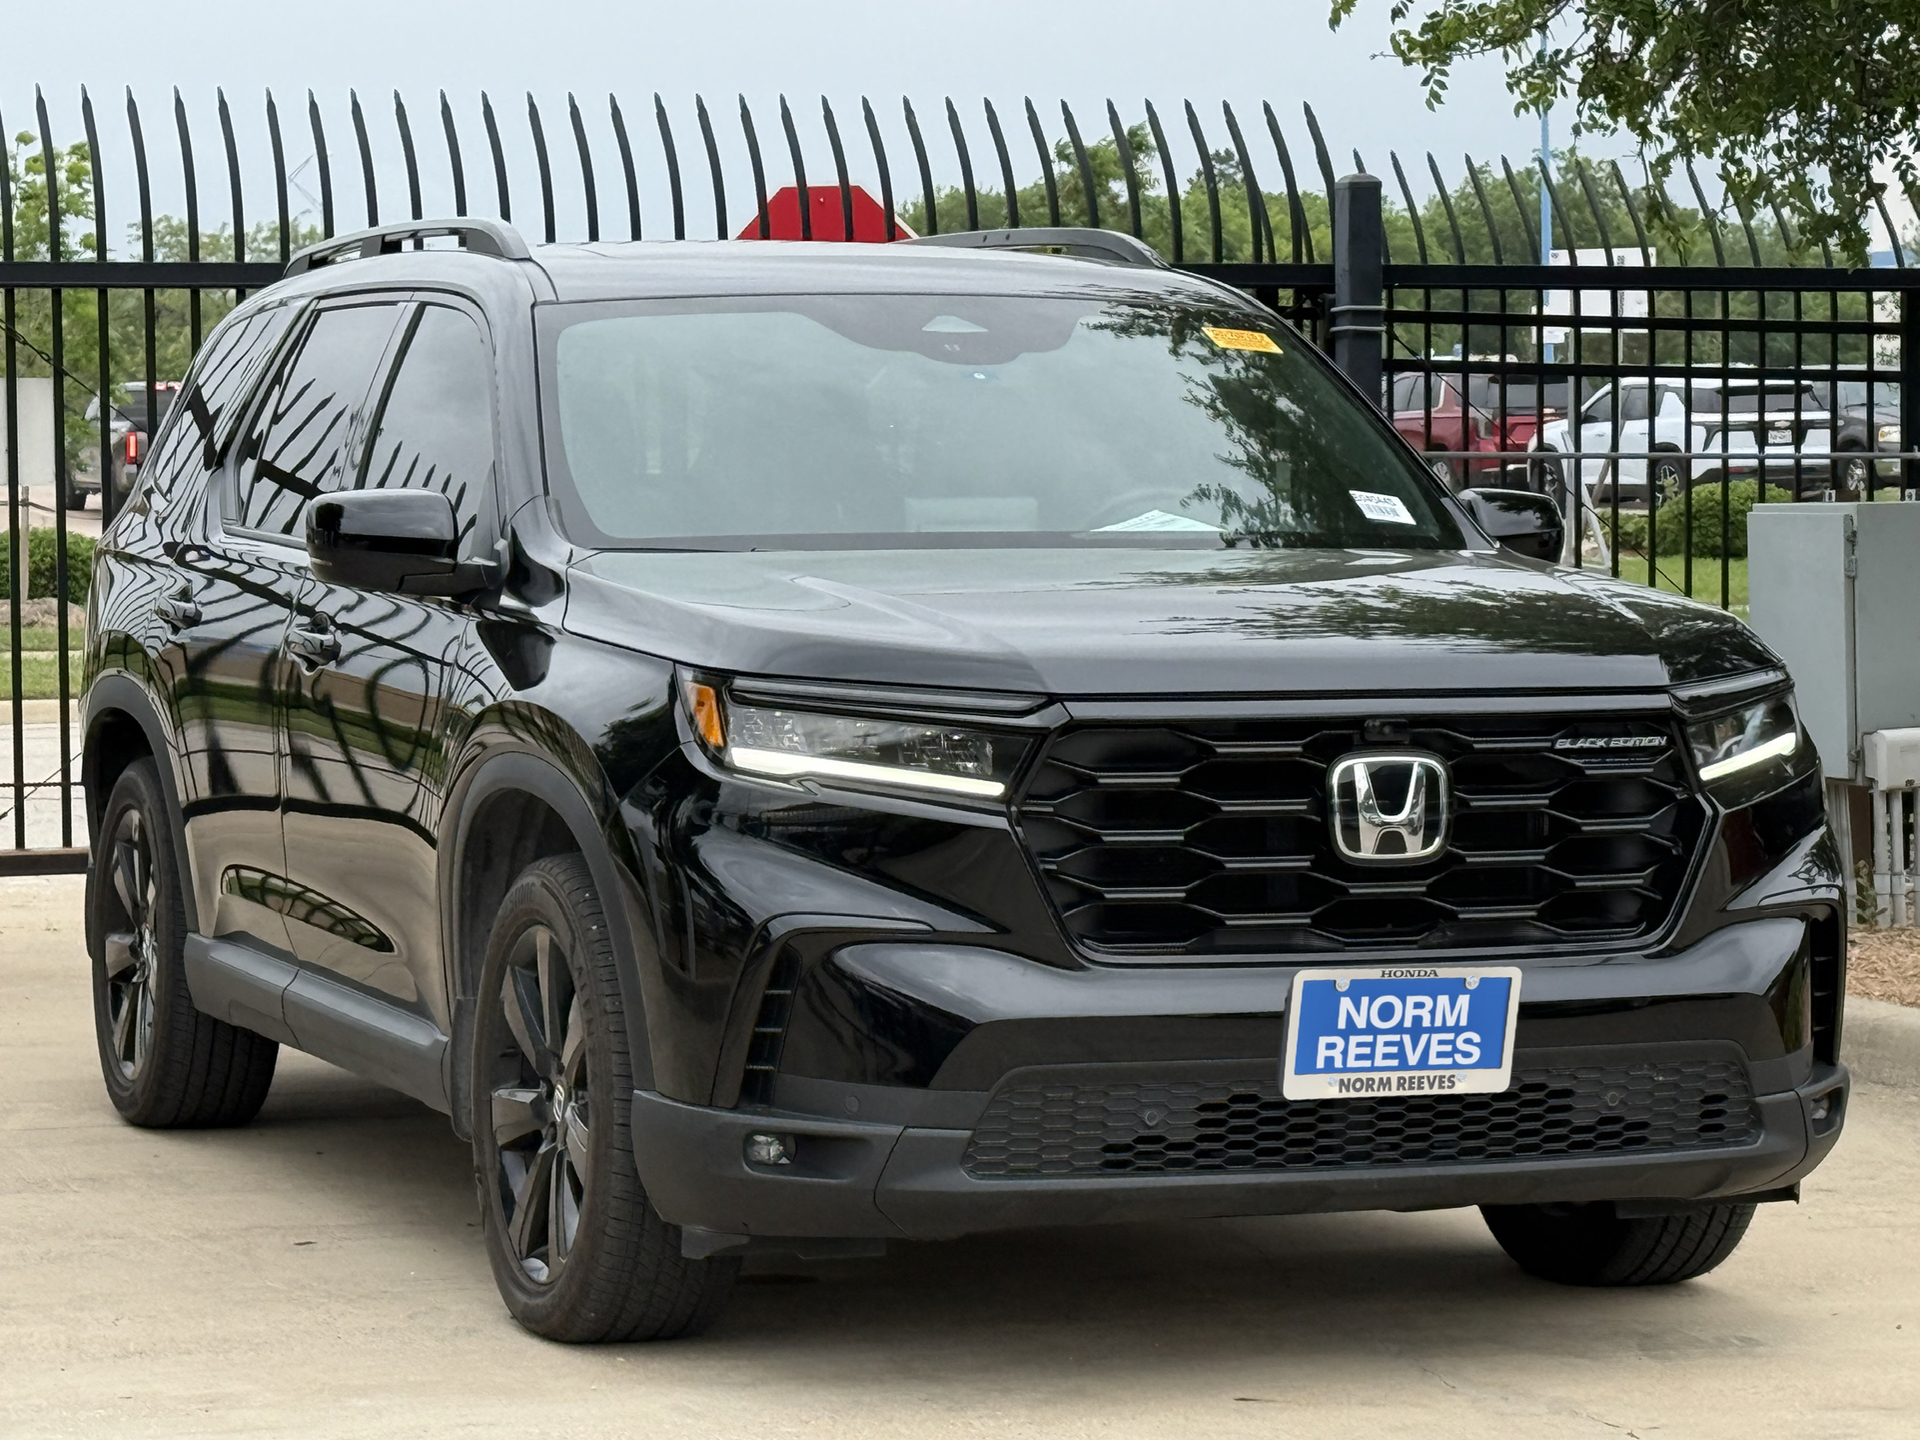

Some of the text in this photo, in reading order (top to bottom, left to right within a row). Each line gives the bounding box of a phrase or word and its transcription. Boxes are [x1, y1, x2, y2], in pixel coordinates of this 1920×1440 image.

[1554, 736, 1667, 749] BLACK EDITION
[1380, 969, 1439, 978] HONDA
[1337, 994, 1470, 1029] NORM
[1316, 1031, 1481, 1069] REEVES
[1338, 1074, 1456, 1093] NORM REEVES
